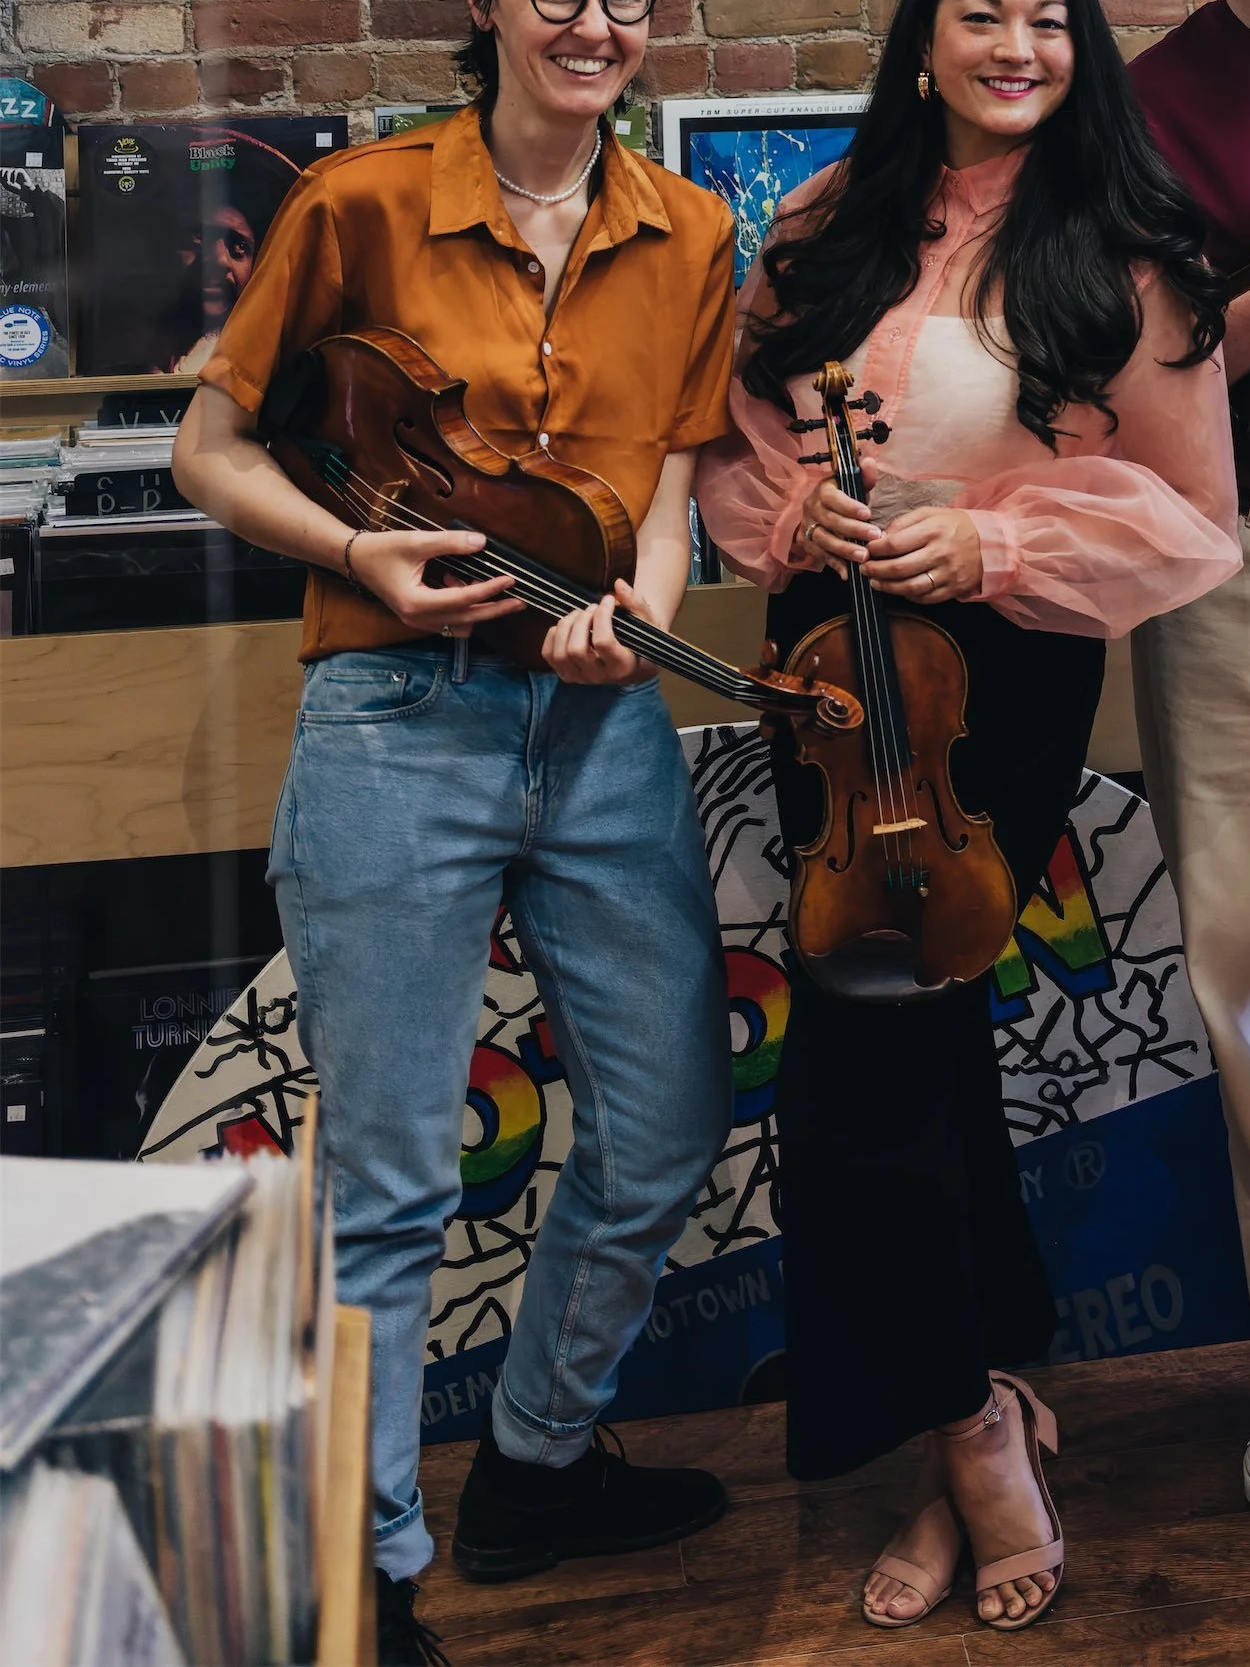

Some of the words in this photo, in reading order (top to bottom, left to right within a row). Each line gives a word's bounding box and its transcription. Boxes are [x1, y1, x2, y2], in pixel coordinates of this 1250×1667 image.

[0, 98, 38, 119] ZZ
[700, 108, 721, 116] TBM
[847, 104, 868, 113] DIS
[189, 144, 236, 160] Black
[190, 158, 236, 172] Unity
[18, 306, 41, 322] NOTE
[33, 330, 48, 358] SERIES
[7, 357, 34, 367] VINYL
[646, 1267, 771, 1343] OTOWN
